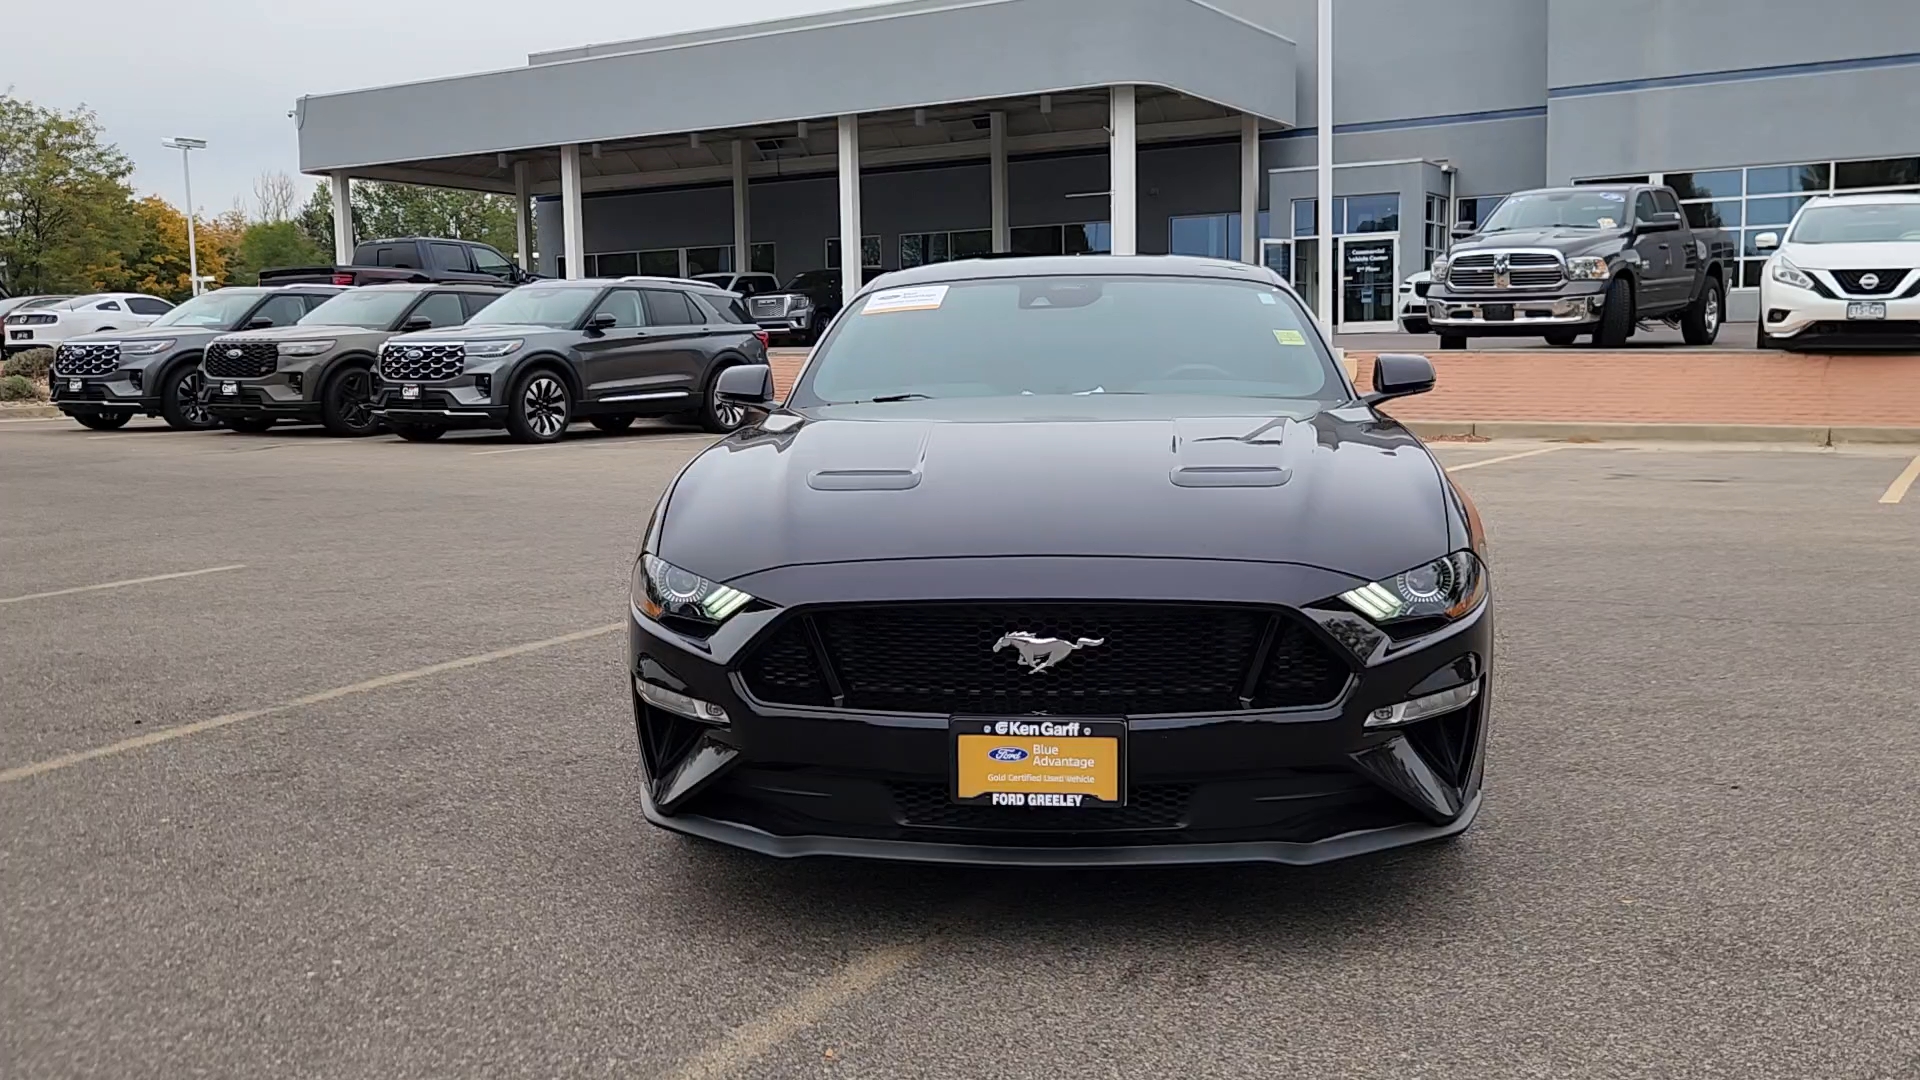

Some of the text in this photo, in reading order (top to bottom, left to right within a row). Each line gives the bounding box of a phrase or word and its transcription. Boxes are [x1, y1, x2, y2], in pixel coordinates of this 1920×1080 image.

[1009, 722, 1040, 736] Ken
[1041, 722, 1080, 737] Garff
[995, 747, 1022, 761] Ford
[1033, 744, 1059, 756] Blue
[1033, 756, 1095, 769] Advantage
[987, 773, 1006, 782] Gold
[1008, 773, 1042, 783] Certified
[992, 792, 1083, 807] FORD GREELEY
